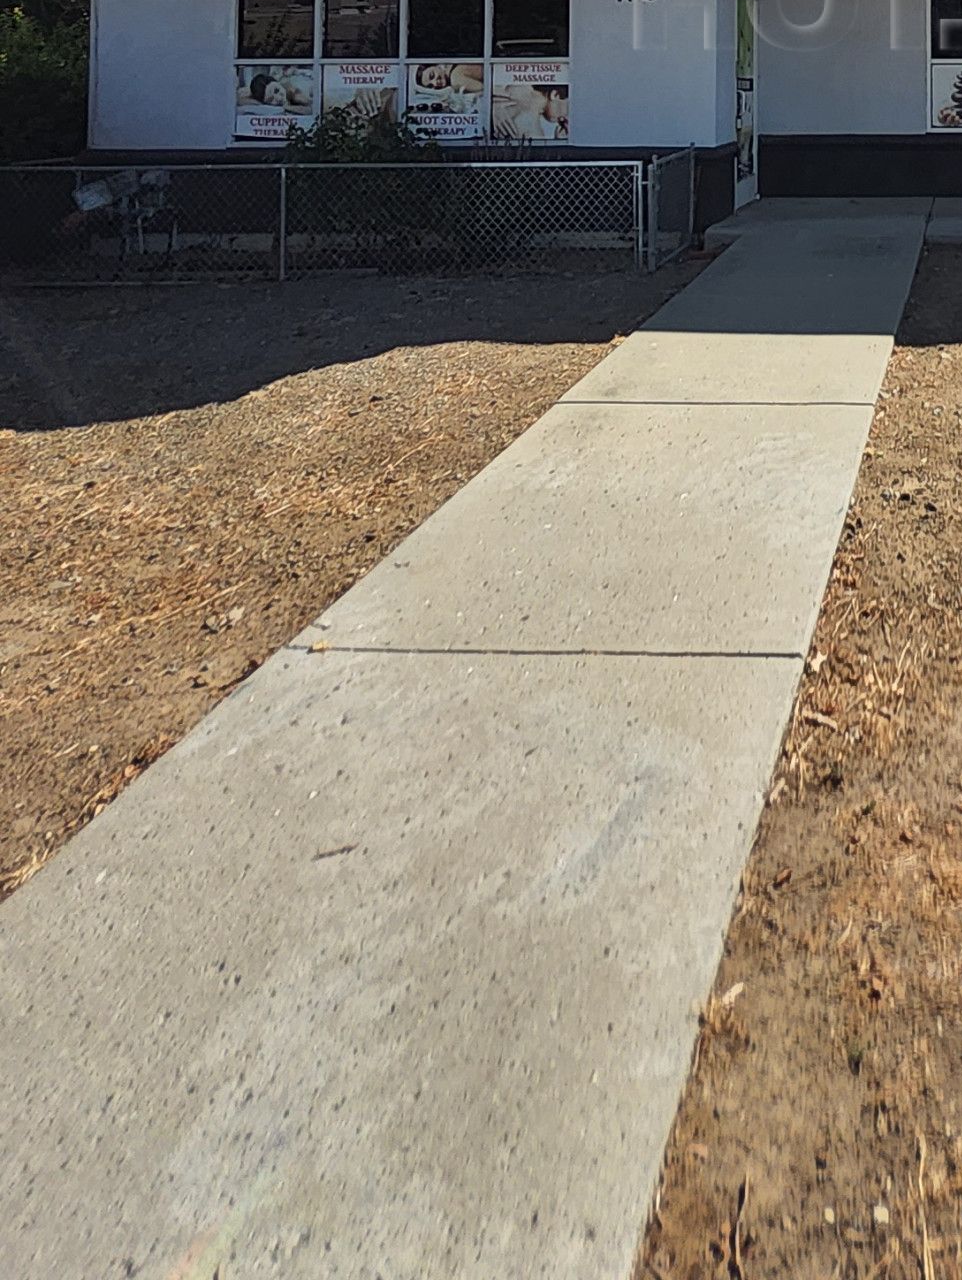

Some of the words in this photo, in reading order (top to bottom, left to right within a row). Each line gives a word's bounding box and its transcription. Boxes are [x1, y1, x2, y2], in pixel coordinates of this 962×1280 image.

[339, 64, 392, 75] MASSAGE
[505, 64, 530, 73] DEEP
[530, 64, 562, 73] TISSUE
[342, 76, 386, 85] THERAPY
[512, 74, 557, 83] MASSAGE
[249, 117, 299, 127] CUPPING
[440, 116, 479, 126] STONE
[253, 128, 290, 137] THERA
